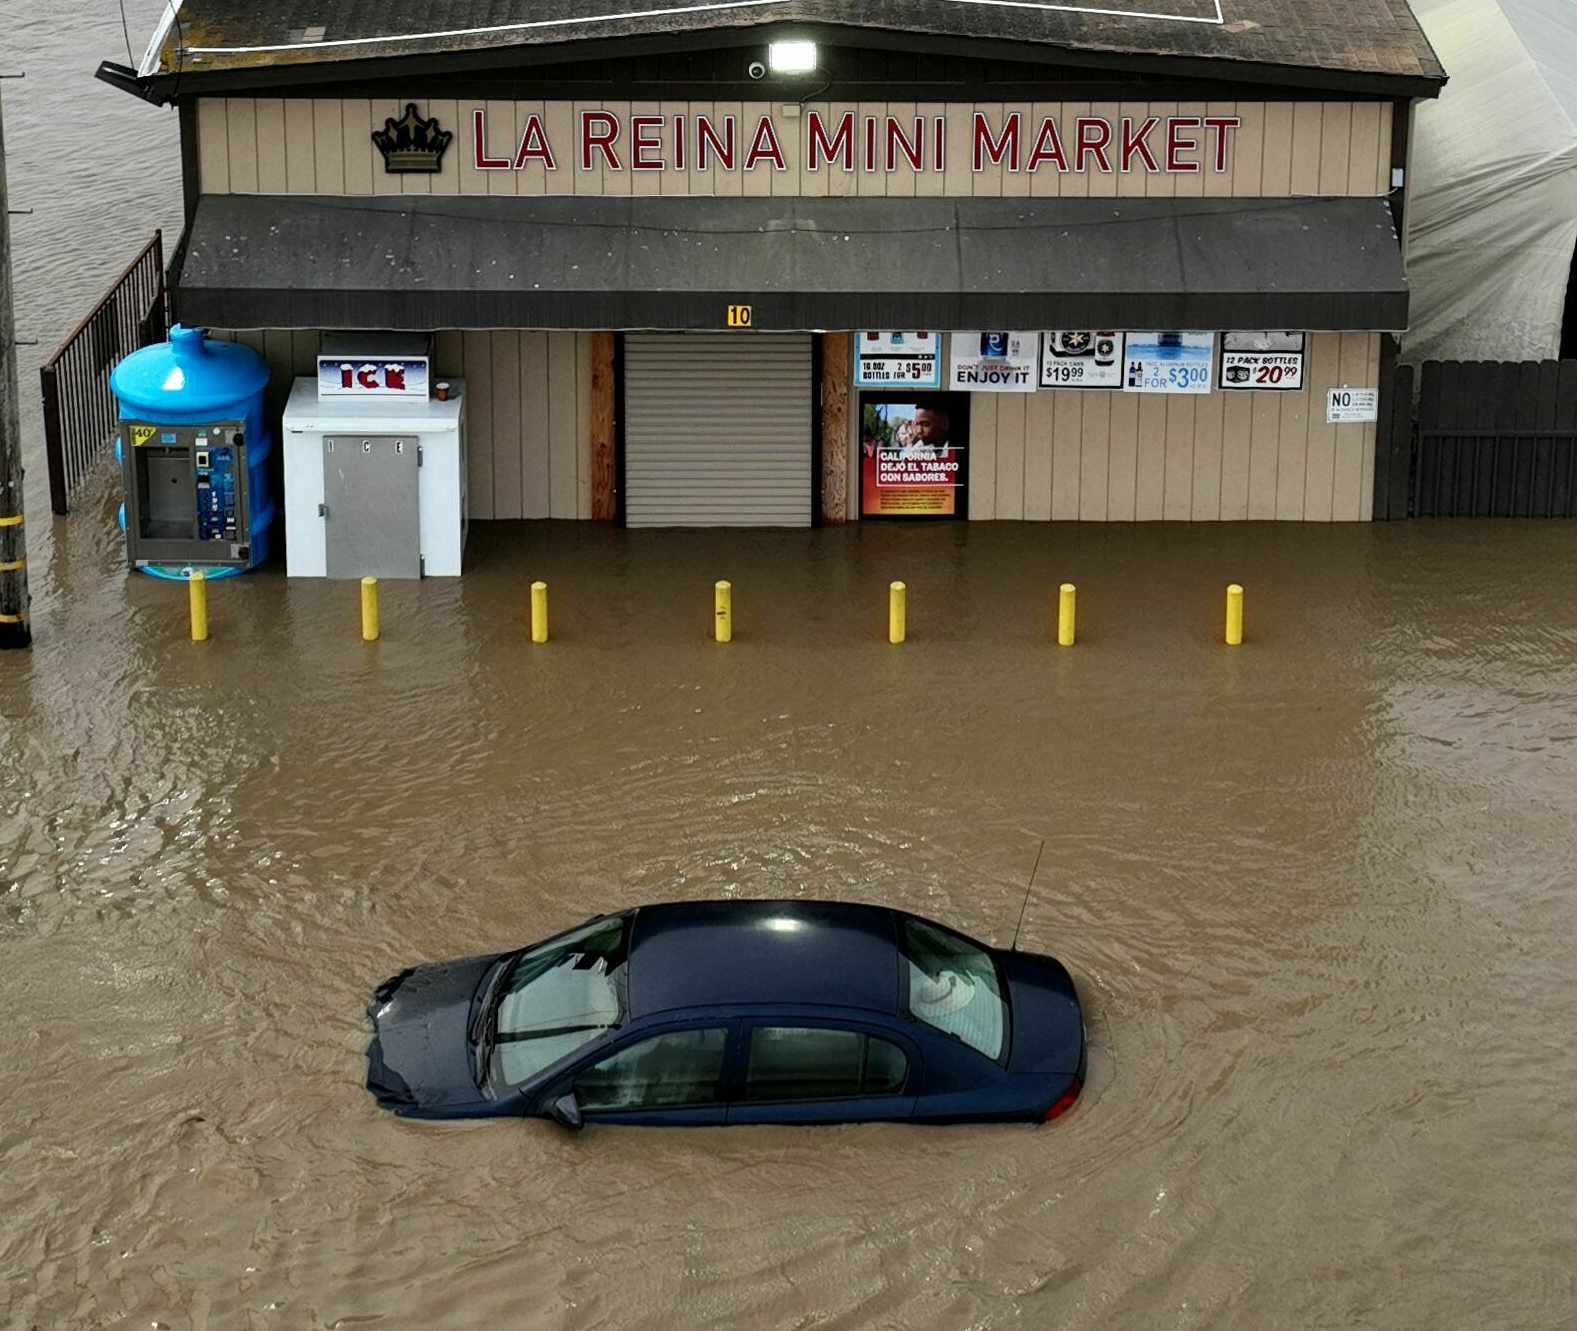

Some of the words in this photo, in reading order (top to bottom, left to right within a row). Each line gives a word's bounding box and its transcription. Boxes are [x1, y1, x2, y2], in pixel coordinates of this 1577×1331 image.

[472, 109, 556, 171] LA
[580, 110, 787, 171] REINA
[806, 110, 944, 173] MINI
[972, 111, 1240, 173] MARKET
[730, 307, 750, 325] 10
[341, 363, 406, 390] ICE
[863, 371, 890, 379] BOTTLES
[958, 371, 1010, 383] ENJOY
[1015, 372, 1029, 383] IT
[1154, 367, 1159, 377] 2
[1144, 378, 1167, 388] FOR
[1332, 392, 1350, 407] NO
[880, 452, 937, 461] CALIFORNIA
[880, 461, 906, 471] DEJÓ
[908, 463, 919, 471] EL
[922, 463, 959, 471] TABACO
[880, 473, 901, 481] CON
[902, 473, 948, 481] SABORES.
